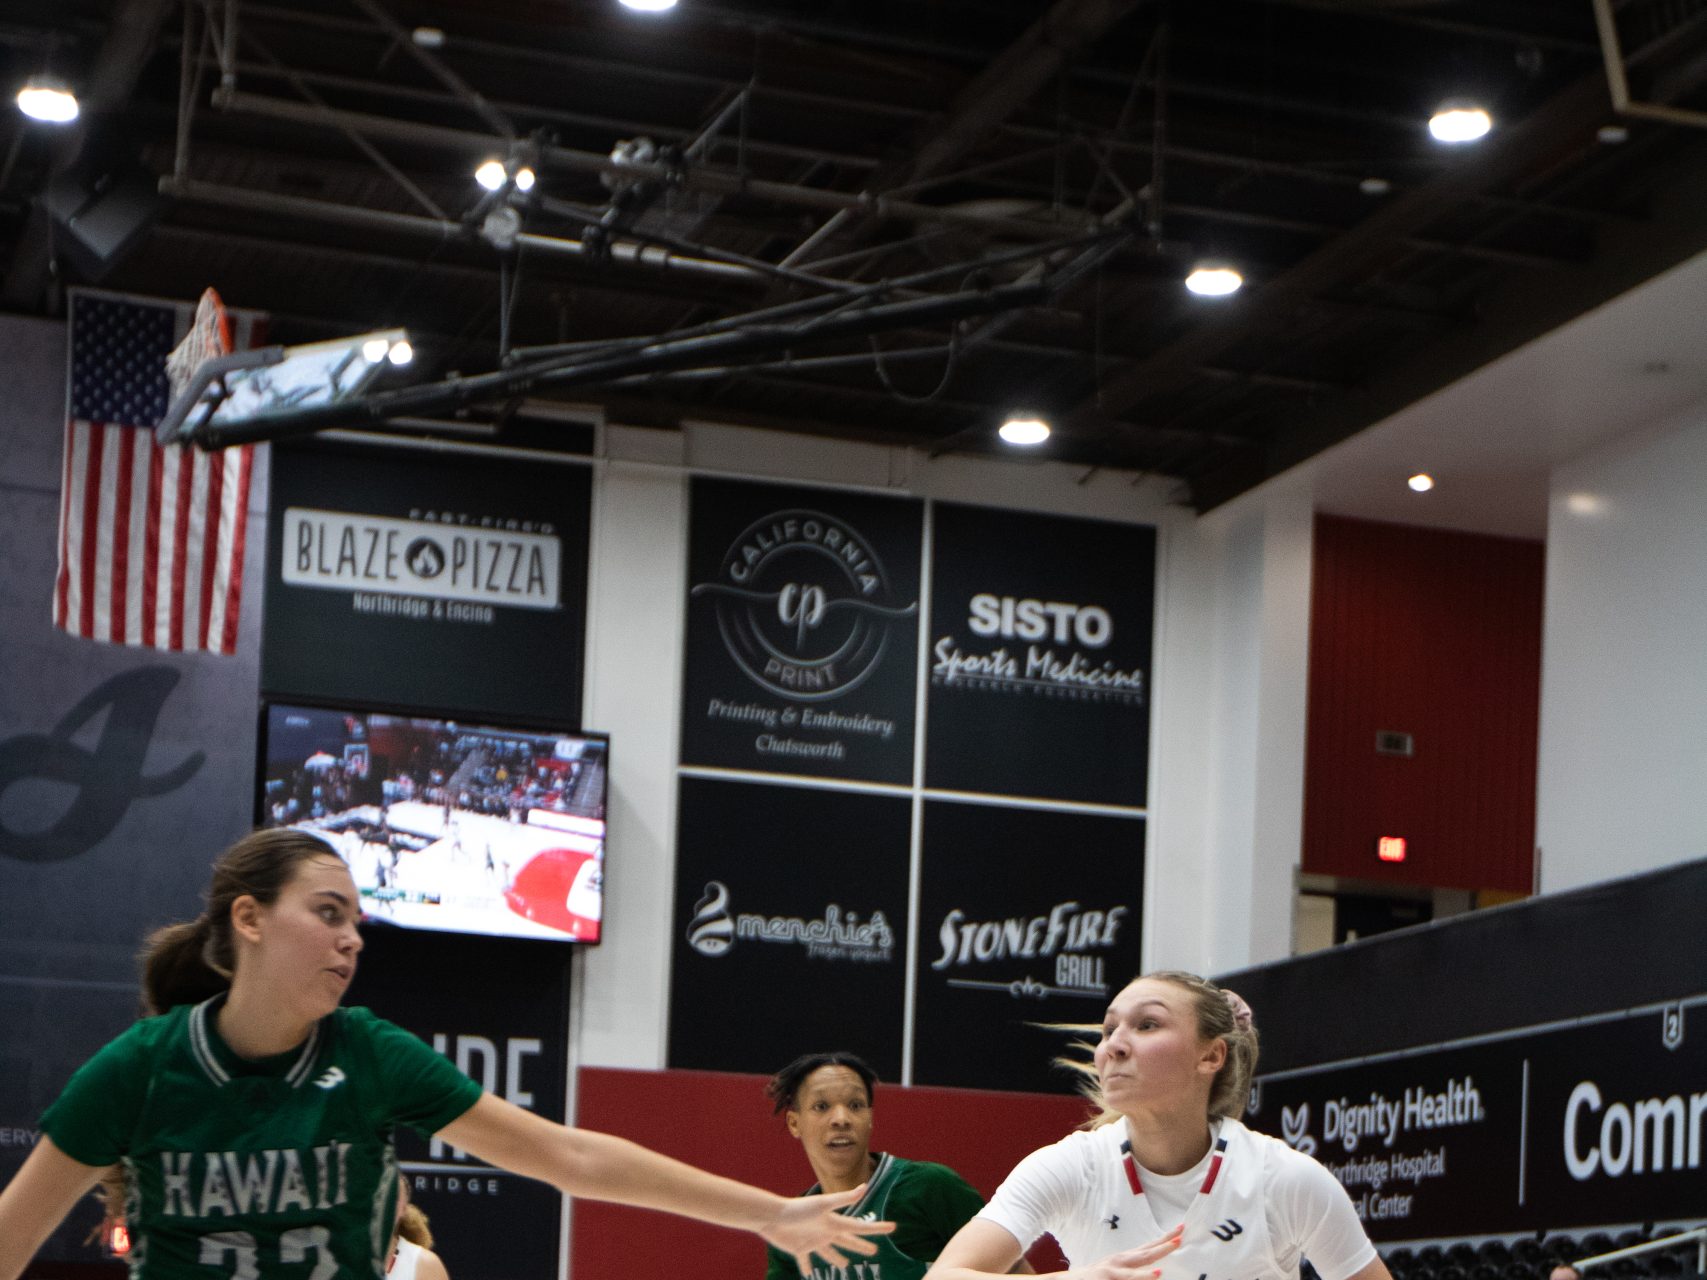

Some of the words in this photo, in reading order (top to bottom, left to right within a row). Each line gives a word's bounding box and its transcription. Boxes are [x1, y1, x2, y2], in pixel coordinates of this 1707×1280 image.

[296, 519, 400, 582] BLAZE
[451, 536, 546, 596] PIZZA
[730, 519, 880, 594] CALIFORNIA
[353, 592, 428, 619] Northridge
[431, 601, 443, 619] &
[446, 603, 493, 624] Encino
[967, 593, 1112, 647] SISTO
[764, 658, 837, 688] PRINT
[933, 636, 1018, 682] Sports
[1024, 645, 1143, 687] Medicine
[707, 699, 777, 728] Printing
[780, 707, 797, 725] &
[801, 709, 894, 739] Embroidery
[755, 734, 844, 759] Chatsworth
[736, 904, 893, 948] menchie's
[1055, 953, 1109, 989] GRILL
[1667, 1014, 1680, 1038] 2
[1323, 1096, 1400, 1151] Dignity
[1325, 1154, 1388, 1190] orthridge
[1391, 1146, 1445, 1185] Hospital
[1369, 1192, 1413, 1219] Center
